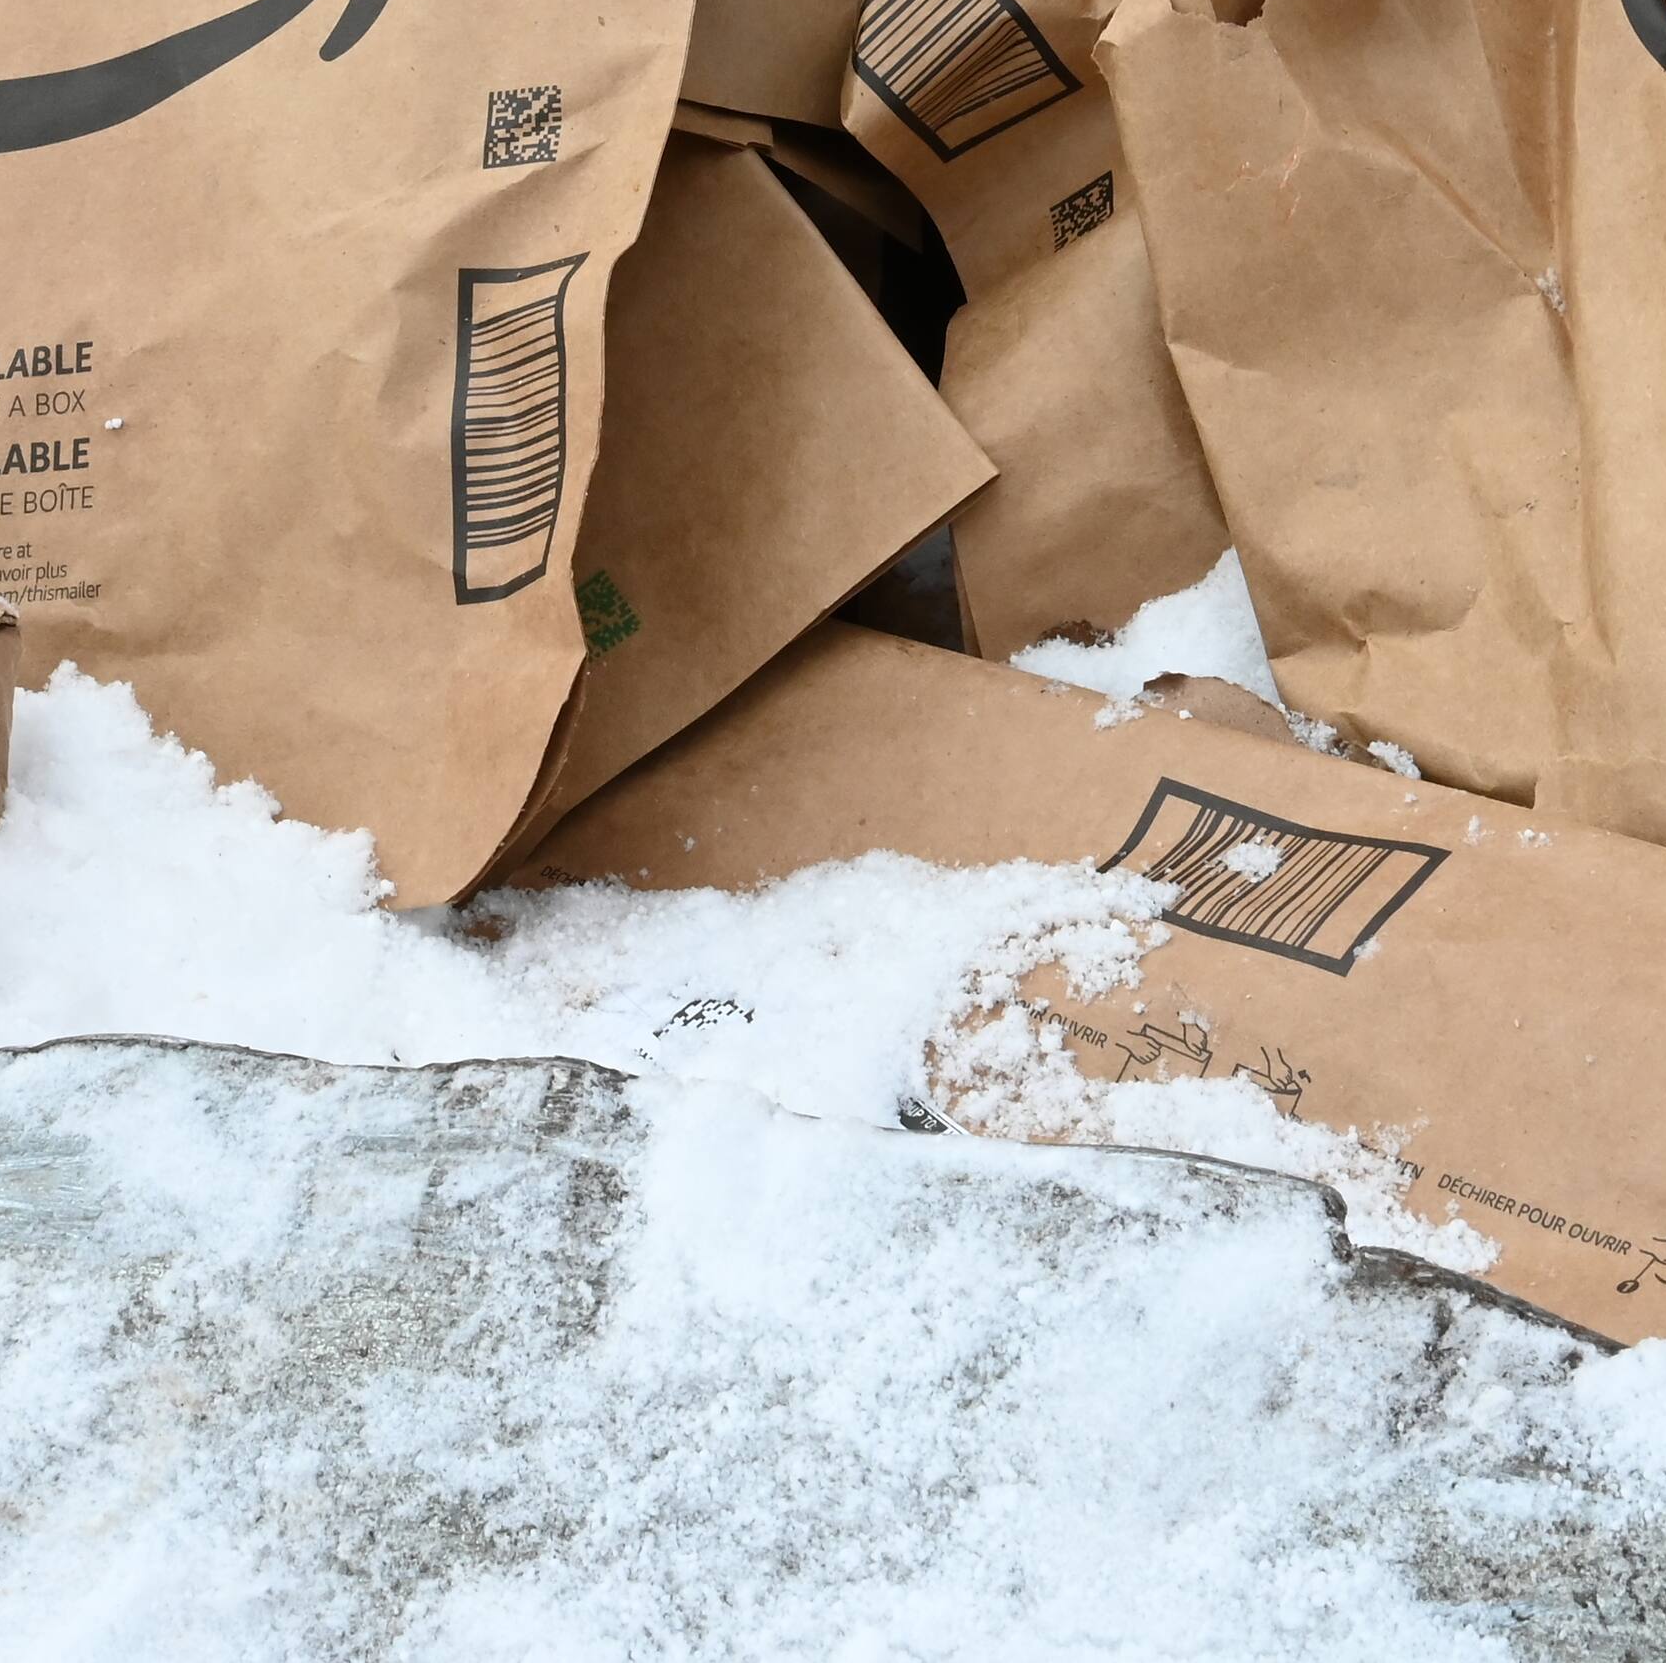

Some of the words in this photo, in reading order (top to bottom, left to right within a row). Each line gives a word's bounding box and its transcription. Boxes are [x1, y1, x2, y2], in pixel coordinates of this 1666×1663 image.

[7, 395, 26, 419] A
[35, 389, 87, 417] BOX
[22, 482, 95, 514] BOÎTE
[16, 543, 33, 559] at
[35, 560, 68, 581] plus
[1436, 1173, 1517, 1215] DÉCHIRER
[1516, 1202, 1567, 1234] POUR
[1568, 1223, 1632, 1256] OUVRIR
